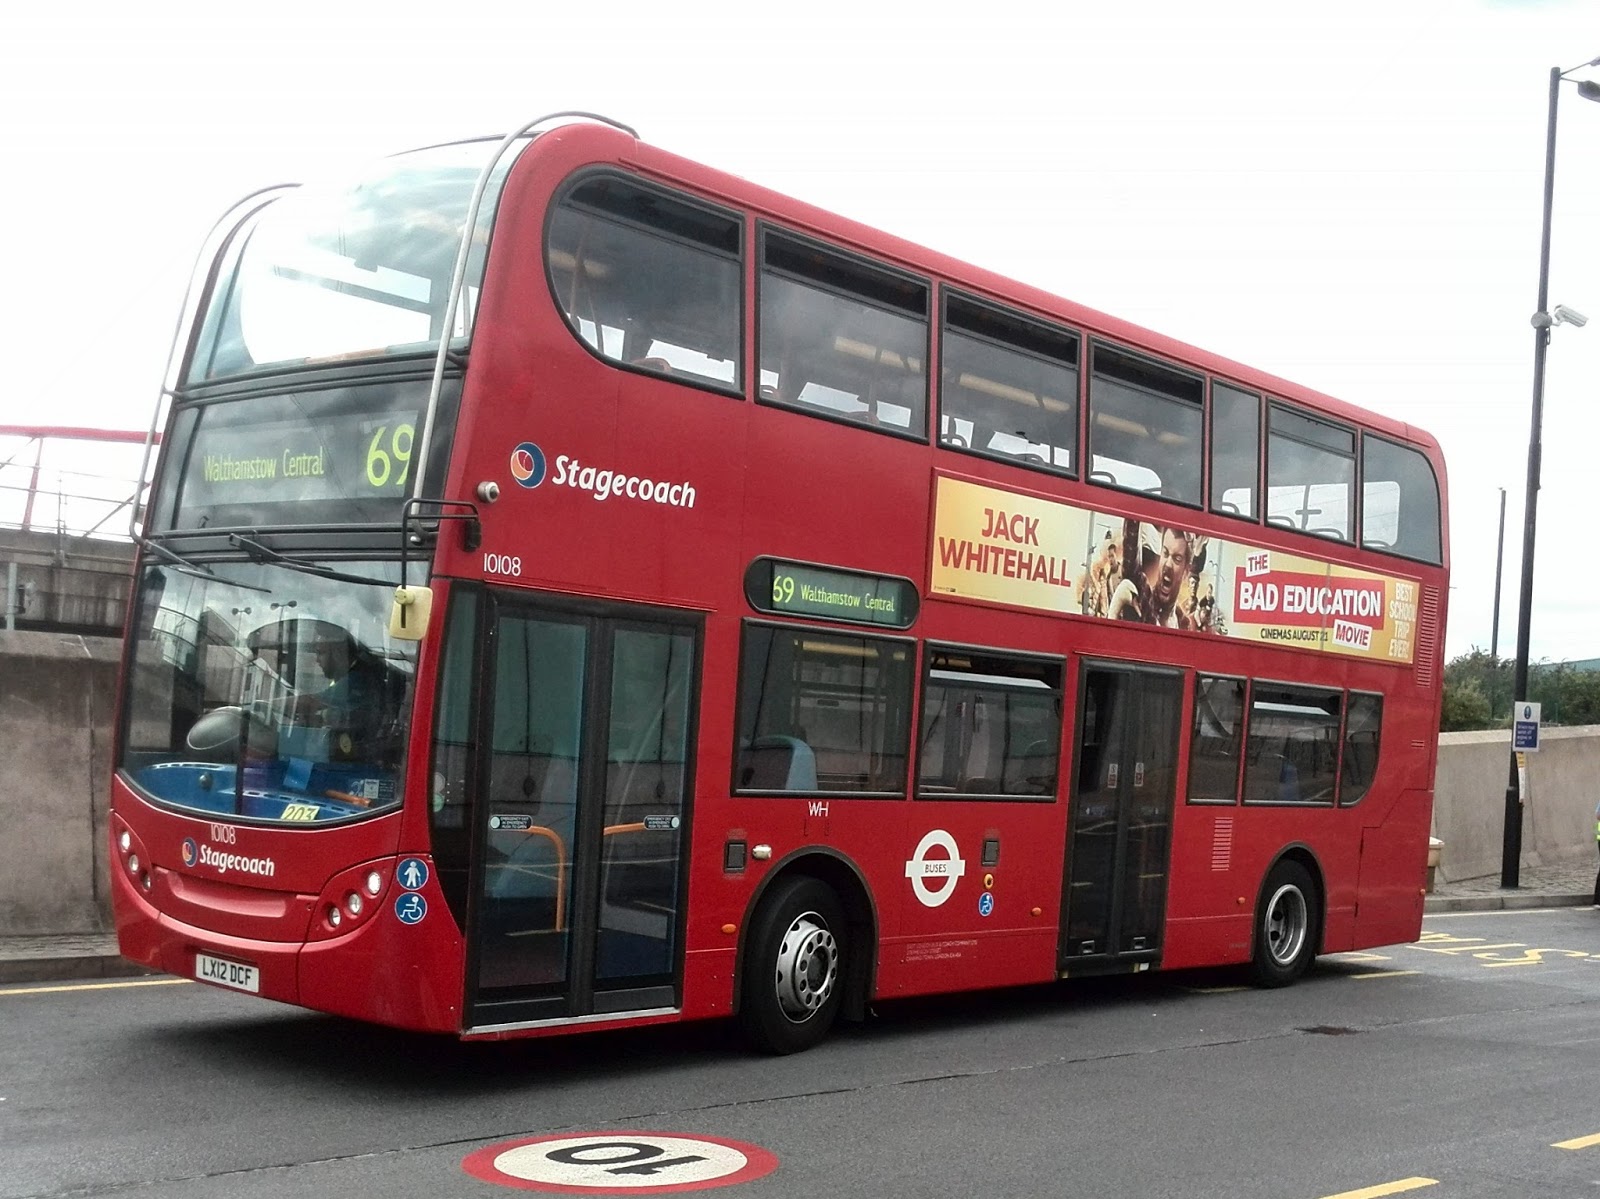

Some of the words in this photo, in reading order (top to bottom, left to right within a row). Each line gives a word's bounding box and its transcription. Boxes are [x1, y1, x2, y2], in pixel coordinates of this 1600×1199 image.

[204, 452, 277, 482] Walthamstow
[282, 446, 324, 476] Central
[367, 424, 415, 487] 69
[552, 455, 696, 508] Stagecoach
[981, 507, 1040, 546] JACK
[483, 553, 521, 576] 10108
[938, 536, 1072, 588] WHITEHALL
[1248, 554, 1268, 572] THE
[773, 575, 795, 603] 69
[801, 584, 860, 608] Walthamstow
[864, 592, 895, 612] Central
[1240, 581, 1279, 611] BAD
[1283, 584, 1381, 617] EDUCATION
[1395, 582, 1414, 602] BEST
[1389, 600, 1416, 622] SCHOOL
[1260, 628, 1292, 640] CINEMAS
[1292, 629, 1320, 641] AUGUST
[1335, 624, 1370, 647] MOVIE
[808, 801, 829, 817] WH
[211, 823, 236, 845] 10108
[200, 844, 275, 876] Stagecoach
[925, 864, 947, 873] BUSES
[203, 958, 227, 980] LX12
[230, 964, 252, 985] DCF
[545, 1142, 711, 1175] 10
